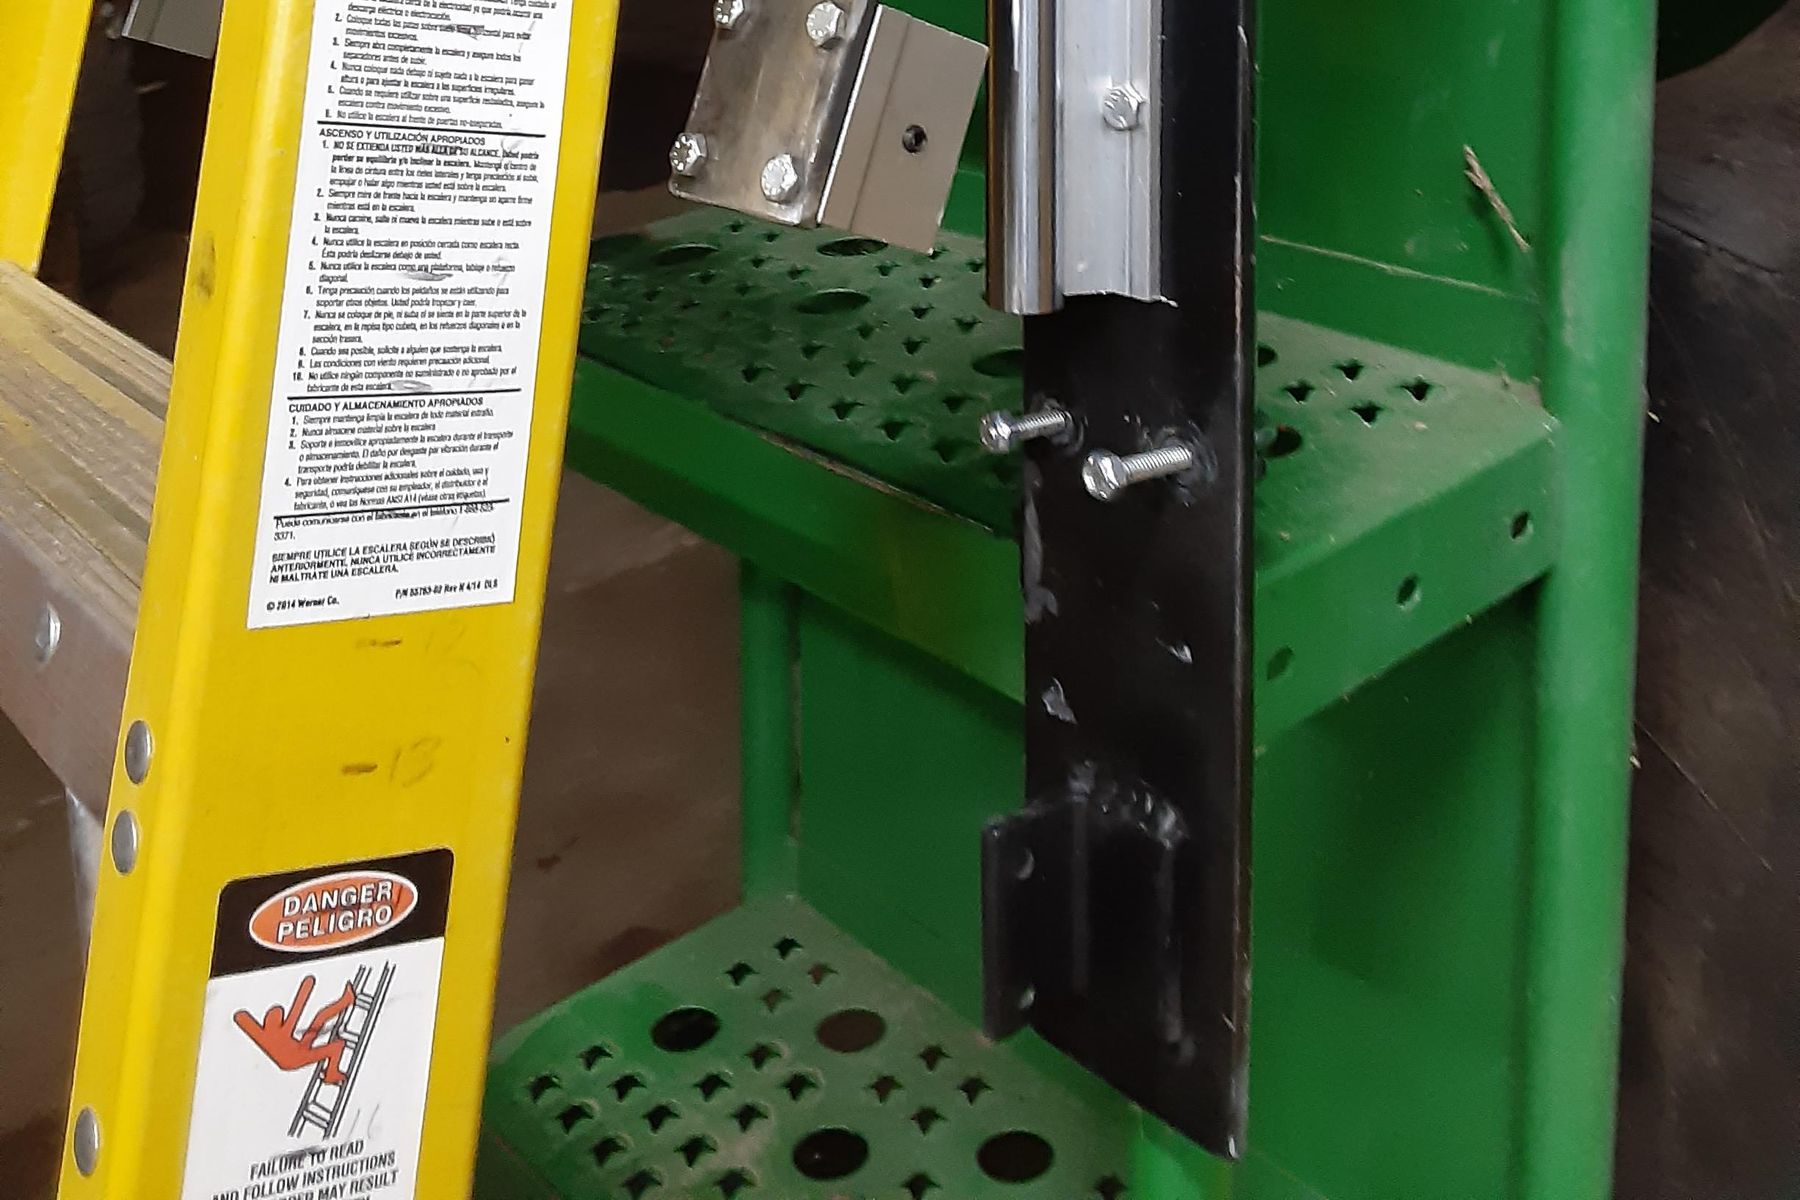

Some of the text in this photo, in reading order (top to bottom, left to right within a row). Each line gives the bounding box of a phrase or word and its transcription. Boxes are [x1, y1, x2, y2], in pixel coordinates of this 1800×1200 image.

[318, 127, 363, 138] ASCENSO
[373, 131, 428, 141] UTILIZACIÓN
[430, 134, 485, 145] APROPIADOS
[288, 402, 331, 412] CUIDADO
[342, 399, 425, 410] ALMACENAMIENTO
[427, 396, 483, 407] APROPIADOS
[270, 545, 495, 573] ANTERIORMENTE. NUNCA UTILICE INCORRECTAMENTE
[280, 570, 328, 583] MALTRATE
[330, 568, 349, 578] UNA
[350, 563, 398, 576] ESCALERA.
[276, 599, 296, 610] 2014
[297, 597, 325, 608] Werner
[283, 879, 393, 918] DANGER
[277, 904, 393, 943] PELIGRO
[243, 1173, 300, 1200] FOLLOW
[302, 1150, 395, 1188] INSTRUCTIONS
[249, 1140, 364, 1181] FAILURE TO READ
[318, 1167, 399, 1200] MAY RESULT
